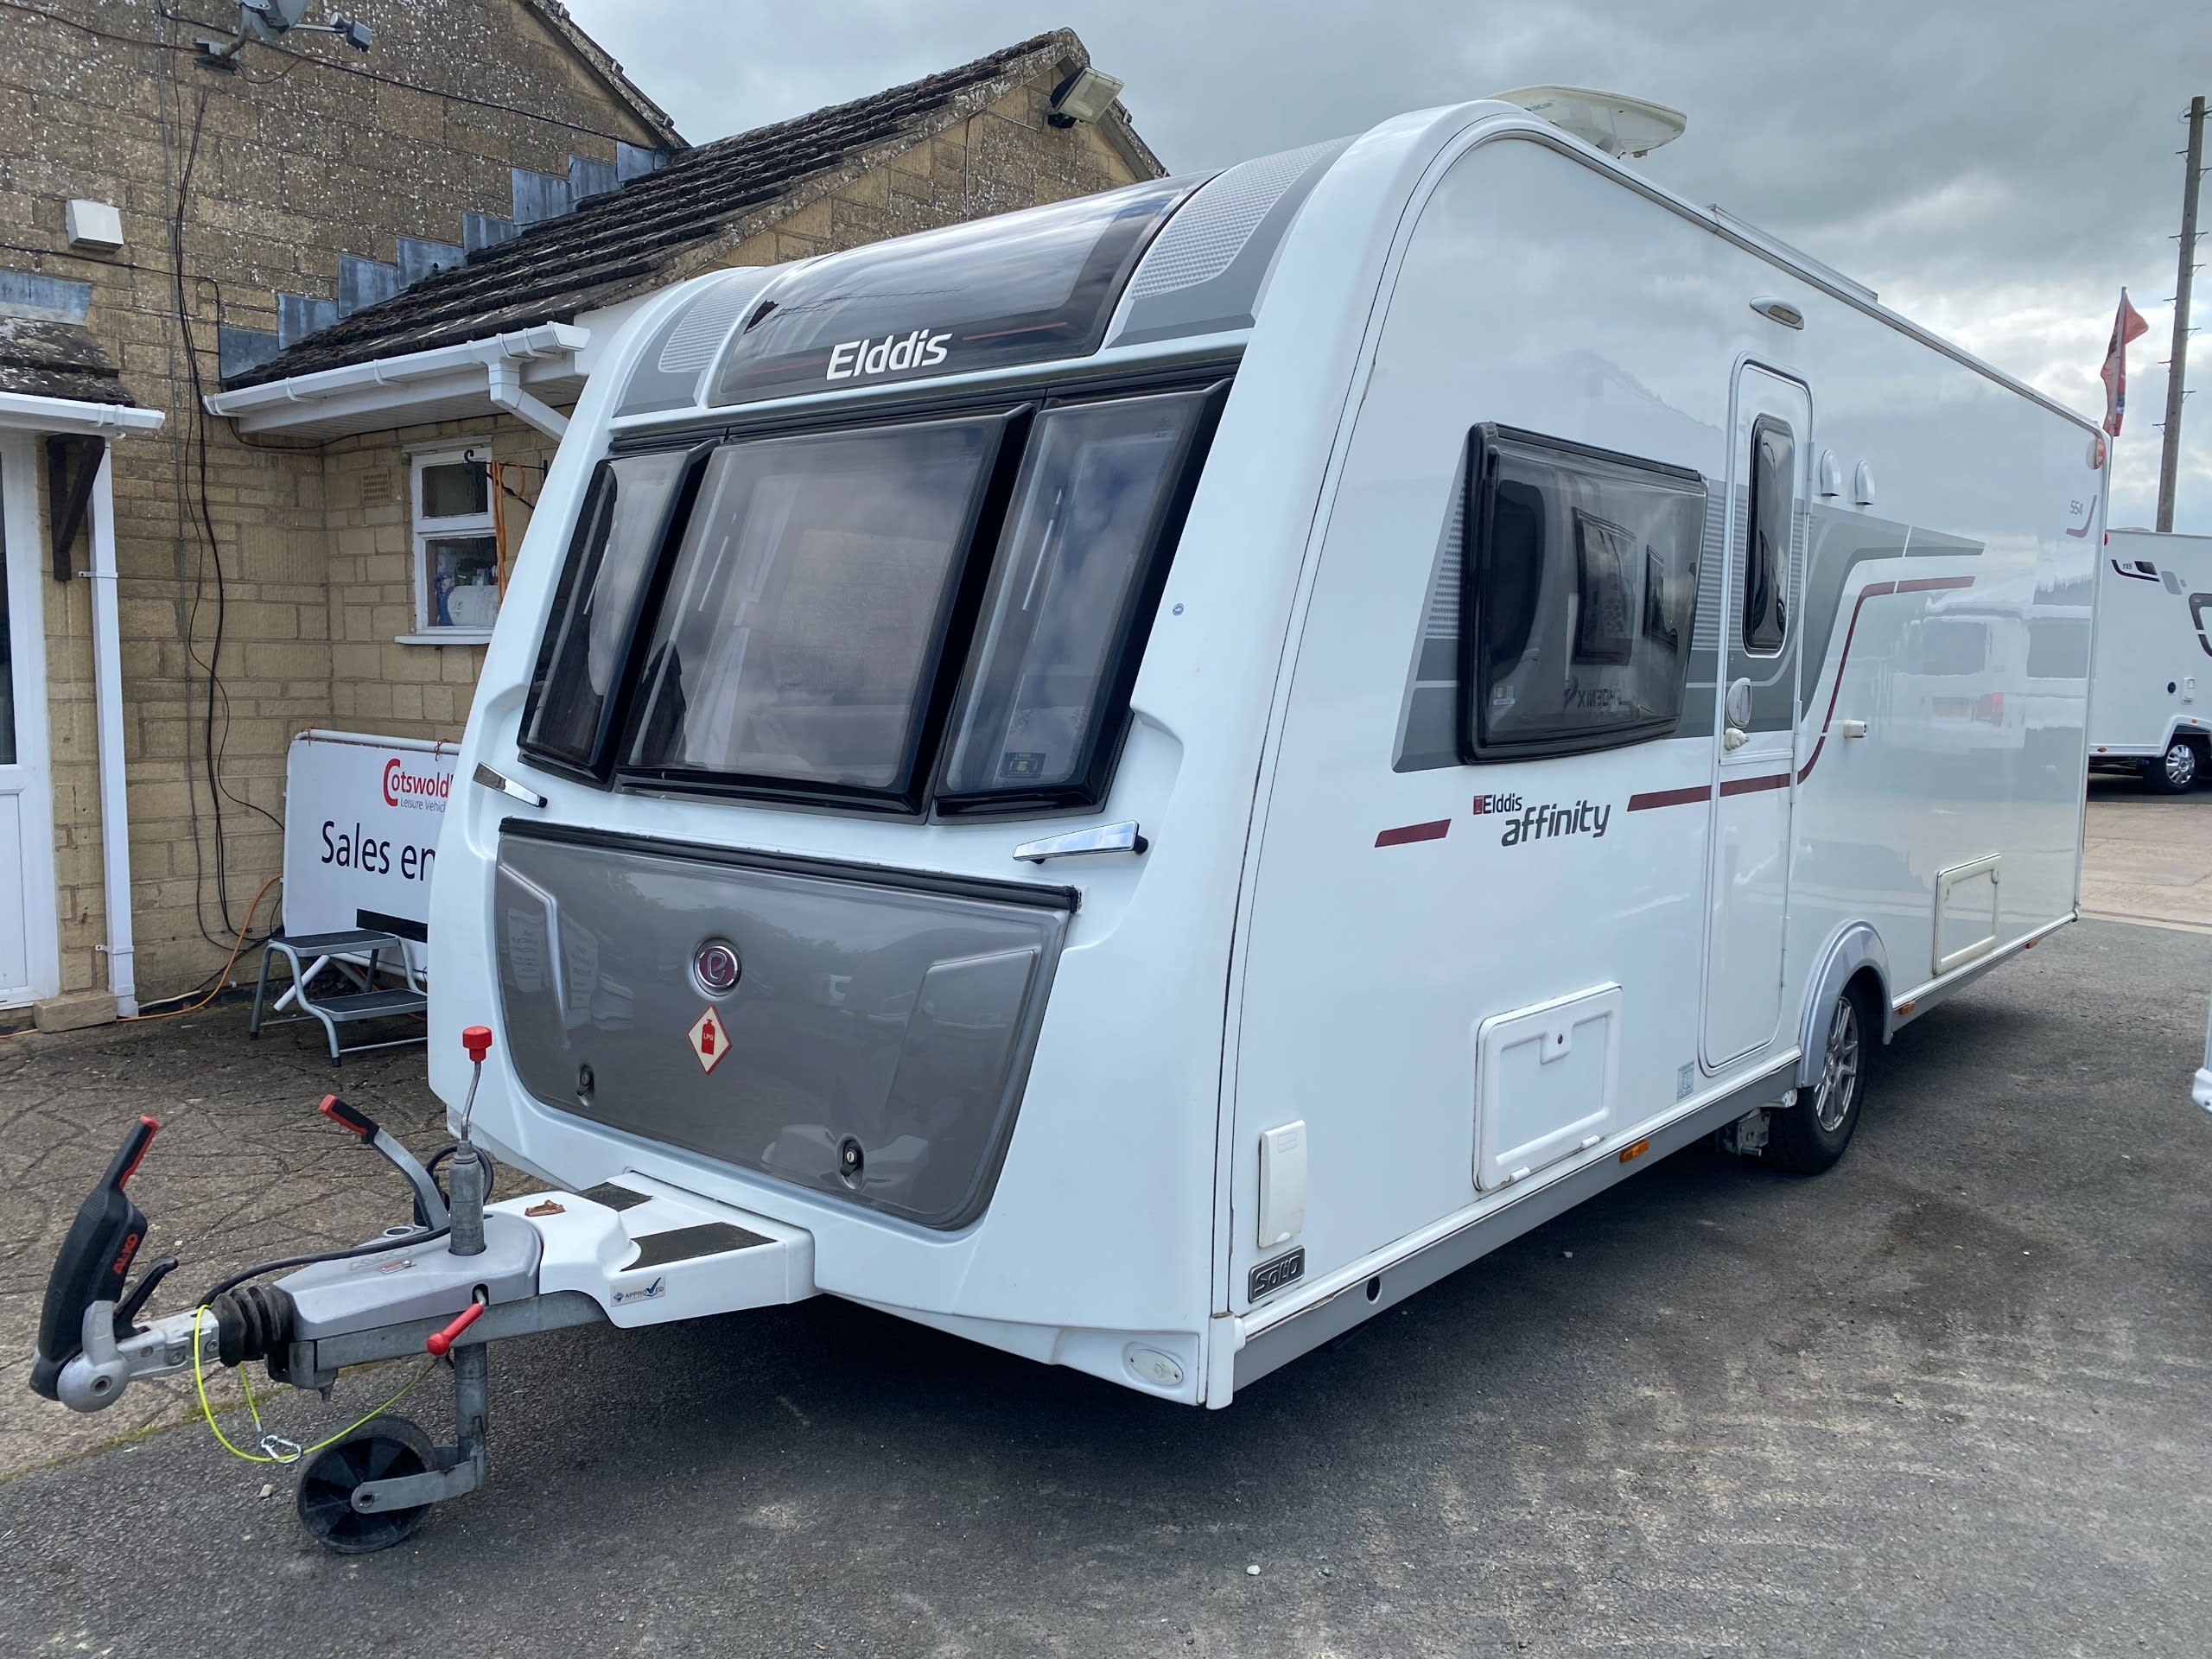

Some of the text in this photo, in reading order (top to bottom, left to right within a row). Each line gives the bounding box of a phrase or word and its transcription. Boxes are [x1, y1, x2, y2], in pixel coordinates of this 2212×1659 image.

[826, 328, 953, 381] Elddis
[400, 796, 423, 810] Leisure
[1483, 792, 1522, 815] Elddis
[1501, 800, 1611, 847] affinity
[321, 820, 391, 874] Sales
[703, 1033, 714, 1041] LPG
